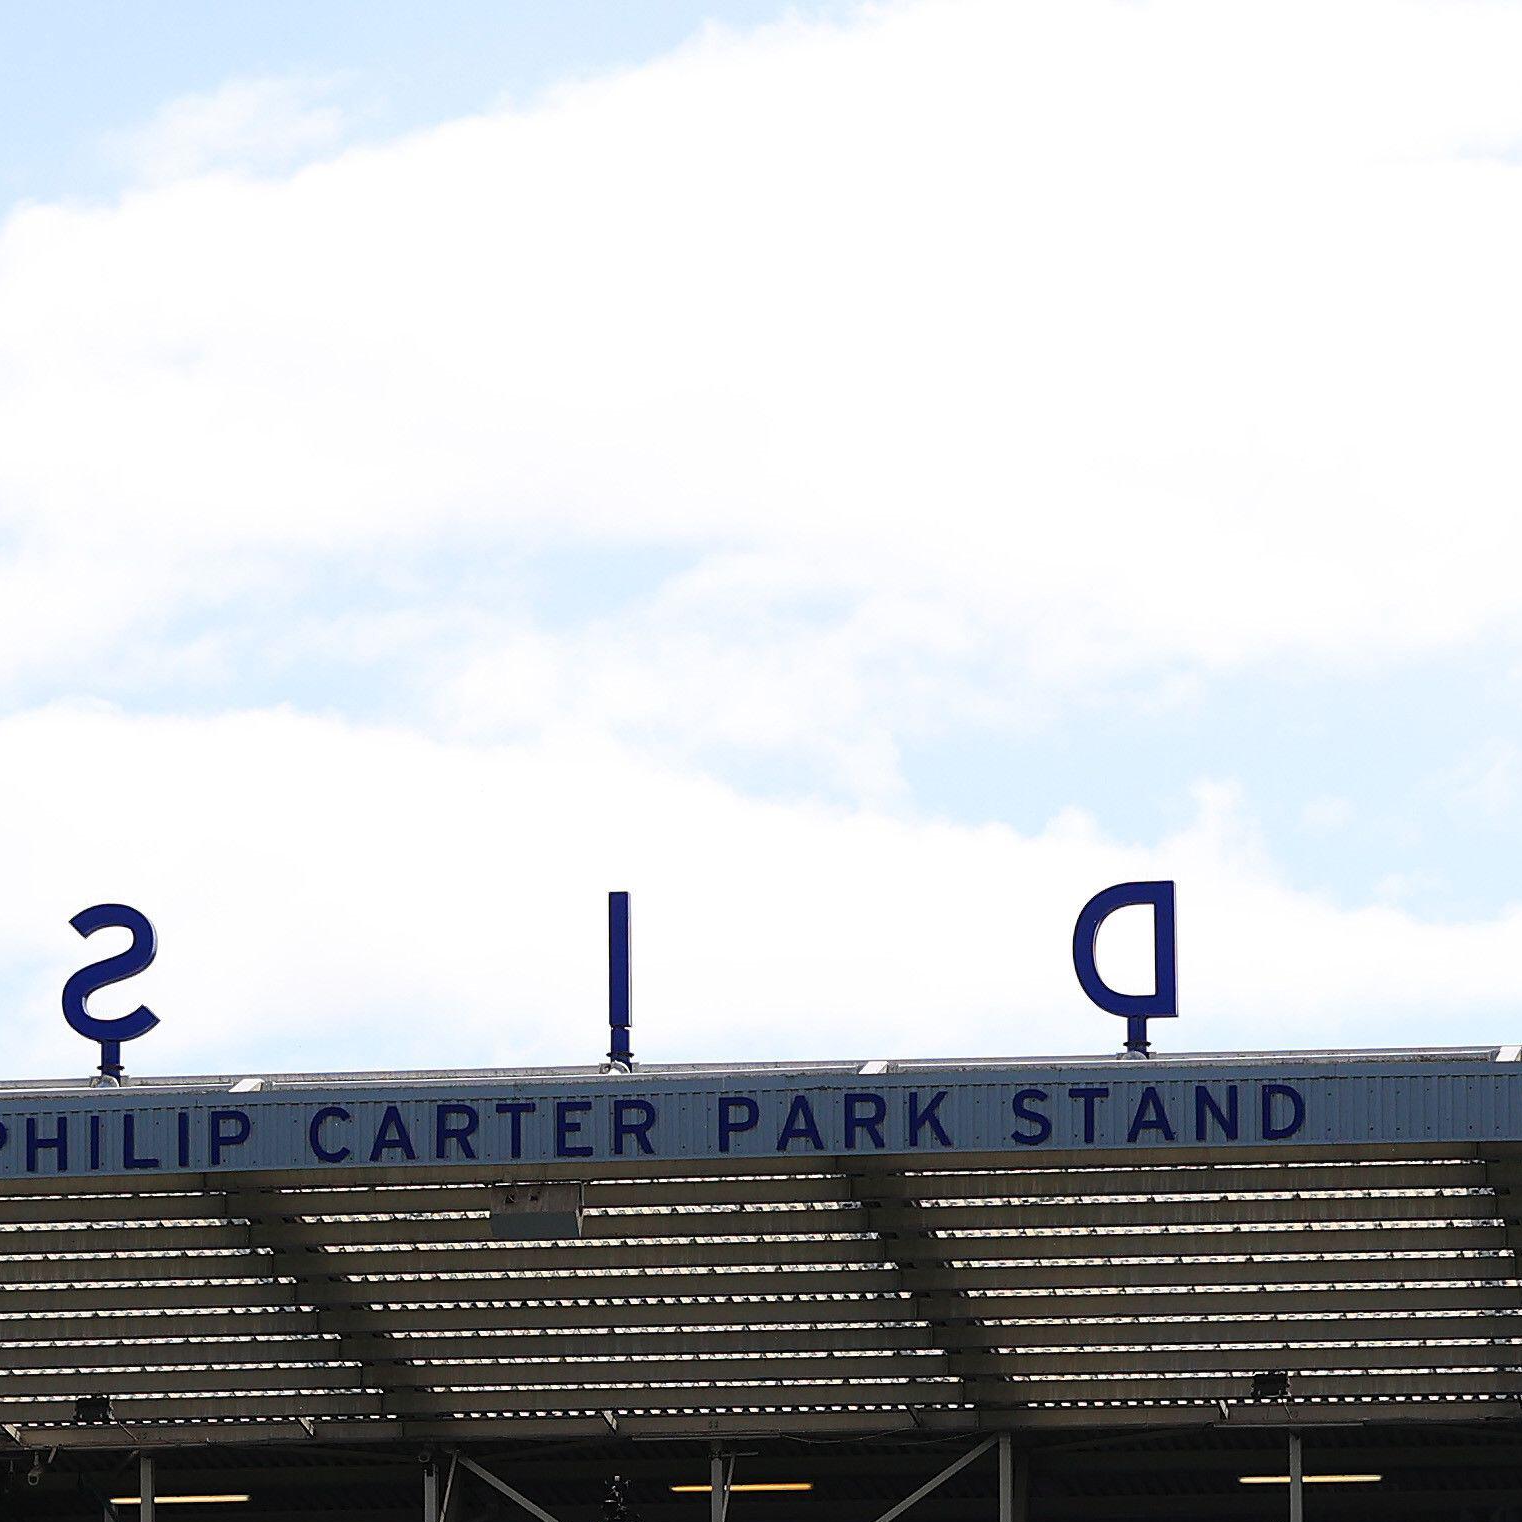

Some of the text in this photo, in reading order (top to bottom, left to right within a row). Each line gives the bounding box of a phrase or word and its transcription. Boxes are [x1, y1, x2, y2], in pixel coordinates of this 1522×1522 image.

[308, 1099, 657, 1164] CARTER
[718, 1090, 955, 1154] PARK
[1010, 1082, 1307, 1146] STAND
